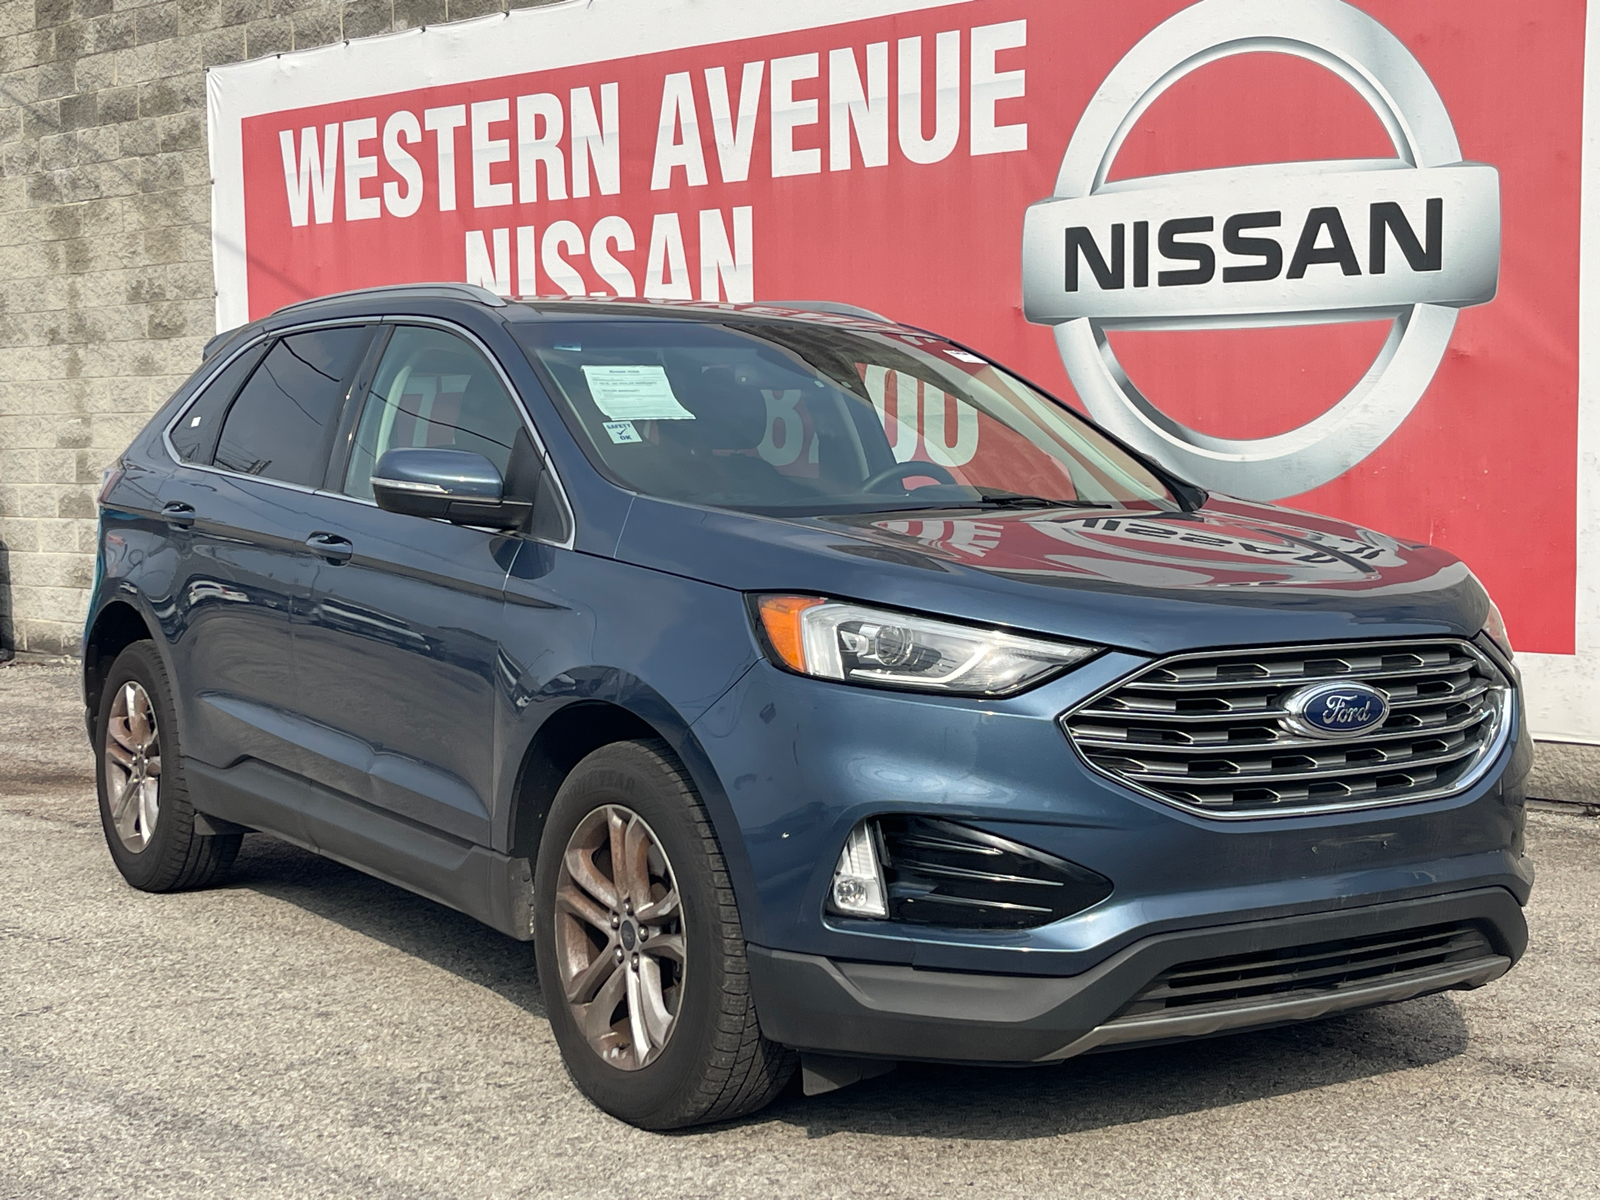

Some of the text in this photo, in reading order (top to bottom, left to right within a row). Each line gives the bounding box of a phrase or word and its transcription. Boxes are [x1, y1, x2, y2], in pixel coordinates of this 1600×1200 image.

[279, 19, 1028, 227] WESTERN AVENUE
[465, 206, 754, 303] NISSAN
[1065, 197, 1443, 292] NISSAN
[1322, 695, 1371, 724] Ford
